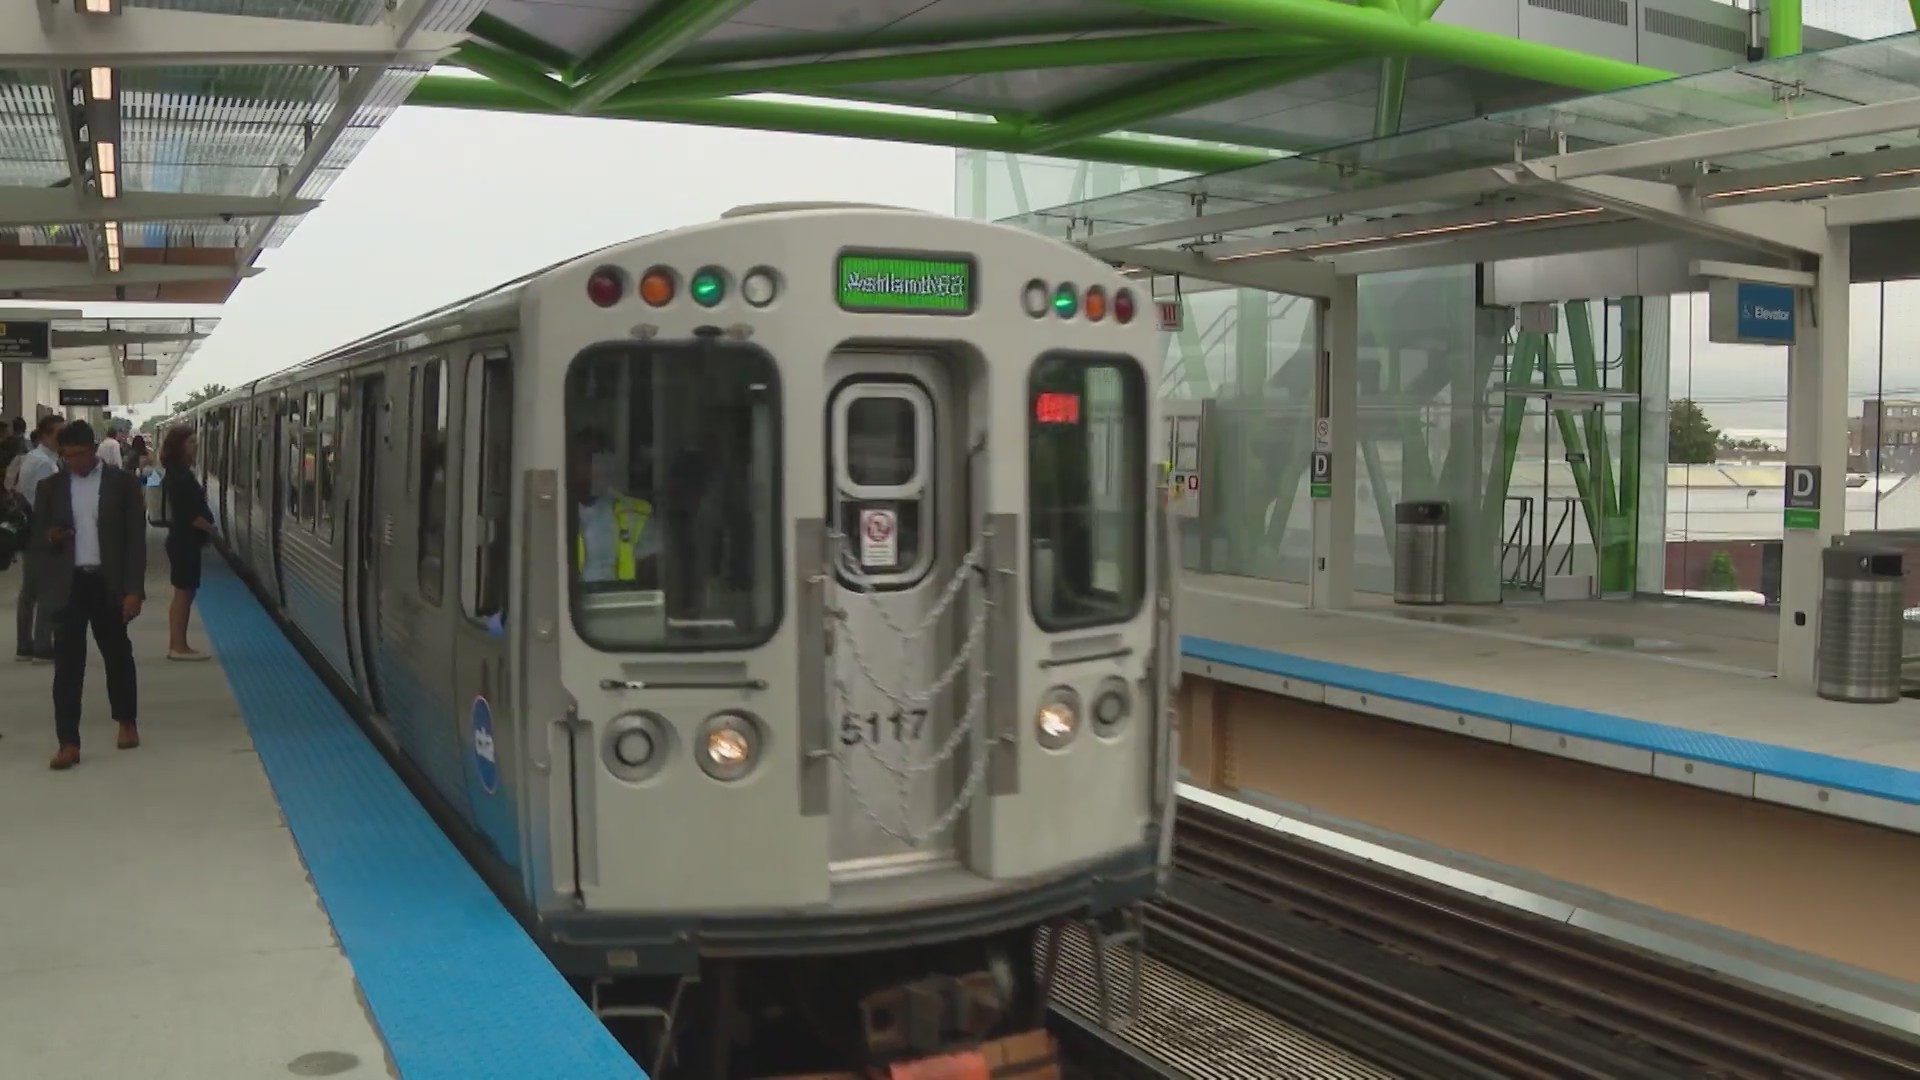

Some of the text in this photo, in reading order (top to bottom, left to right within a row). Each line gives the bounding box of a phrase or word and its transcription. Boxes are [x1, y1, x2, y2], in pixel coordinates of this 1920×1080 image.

[1754, 305, 1790, 320] Elevator
[1315, 455, 1328, 475] D
[1793, 469, 1814, 496] D
[841, 709, 927, 745] 5117
